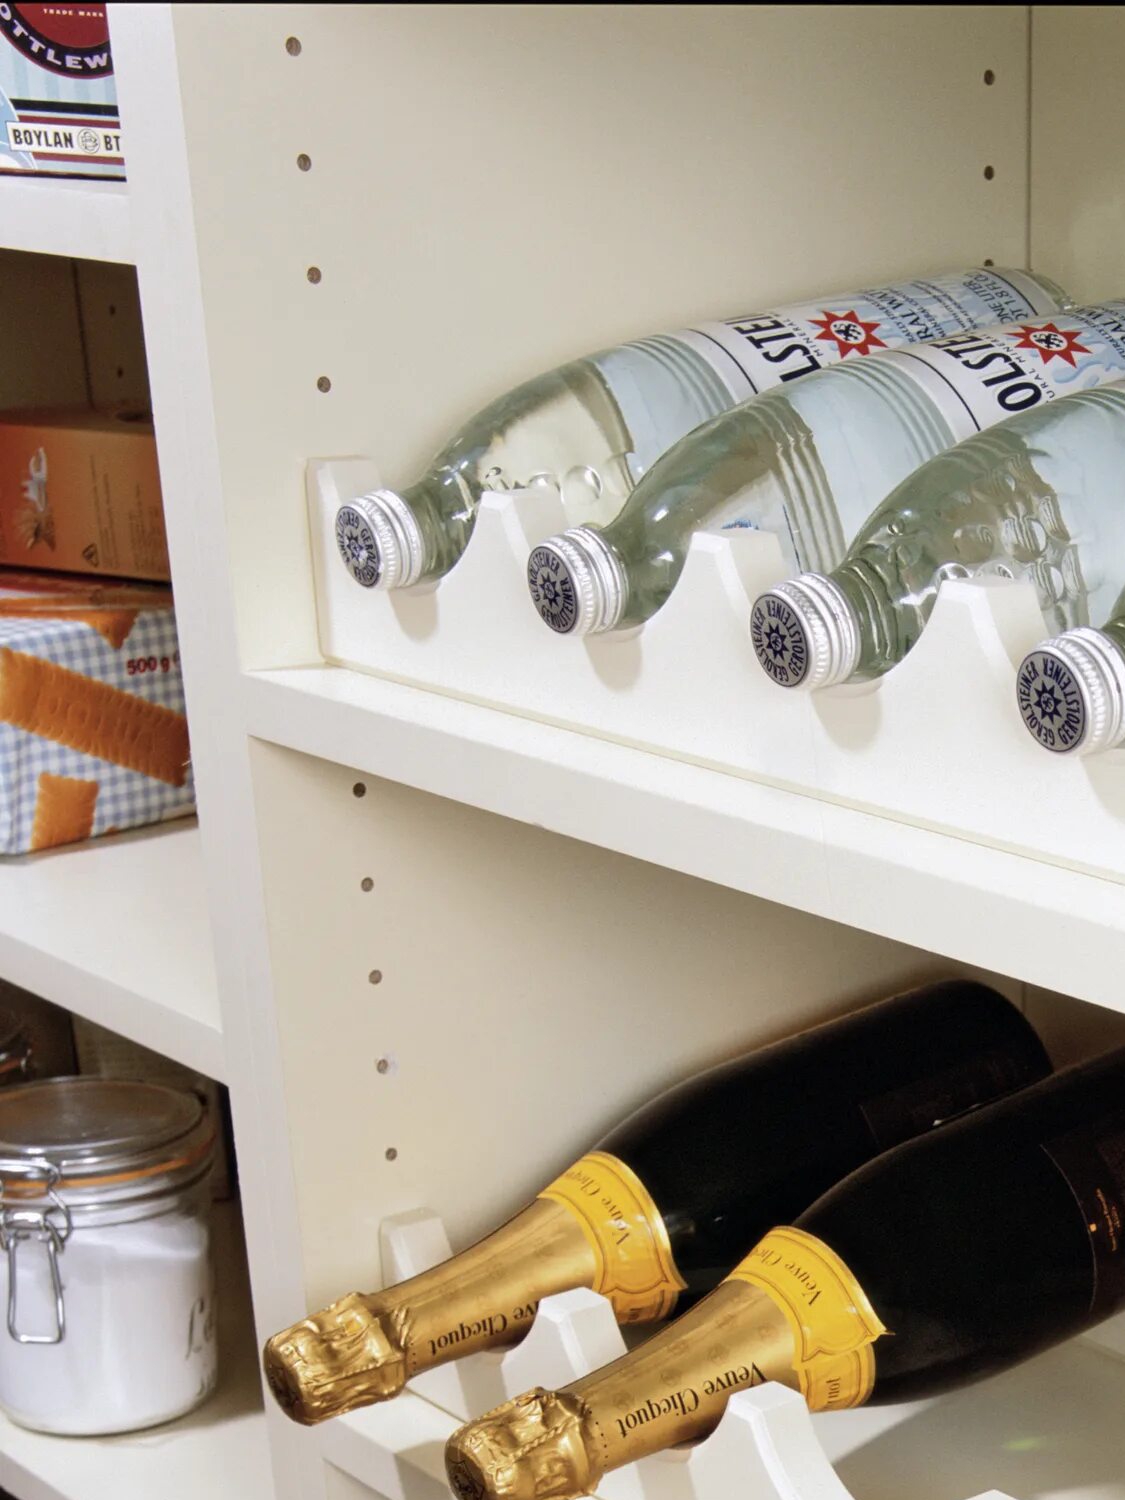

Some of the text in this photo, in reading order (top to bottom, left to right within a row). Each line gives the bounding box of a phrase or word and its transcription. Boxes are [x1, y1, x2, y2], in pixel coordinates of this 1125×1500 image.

[43, 8, 73, 16] TRADE
[13, 128, 121, 152] BOYLAN BT
[1028, 368, 1056, 401] URAL
[127, 656, 158, 676] 500
[1020, 661, 1056, 746] GEROLSTEINER
[1042, 657, 1081, 745] GEROLSTEINER
[785, 1261, 823, 1307] Veuve
[428, 1312, 509, 1357] Clicquot
[615, 1361, 768, 1439] Veuve Clicquot
